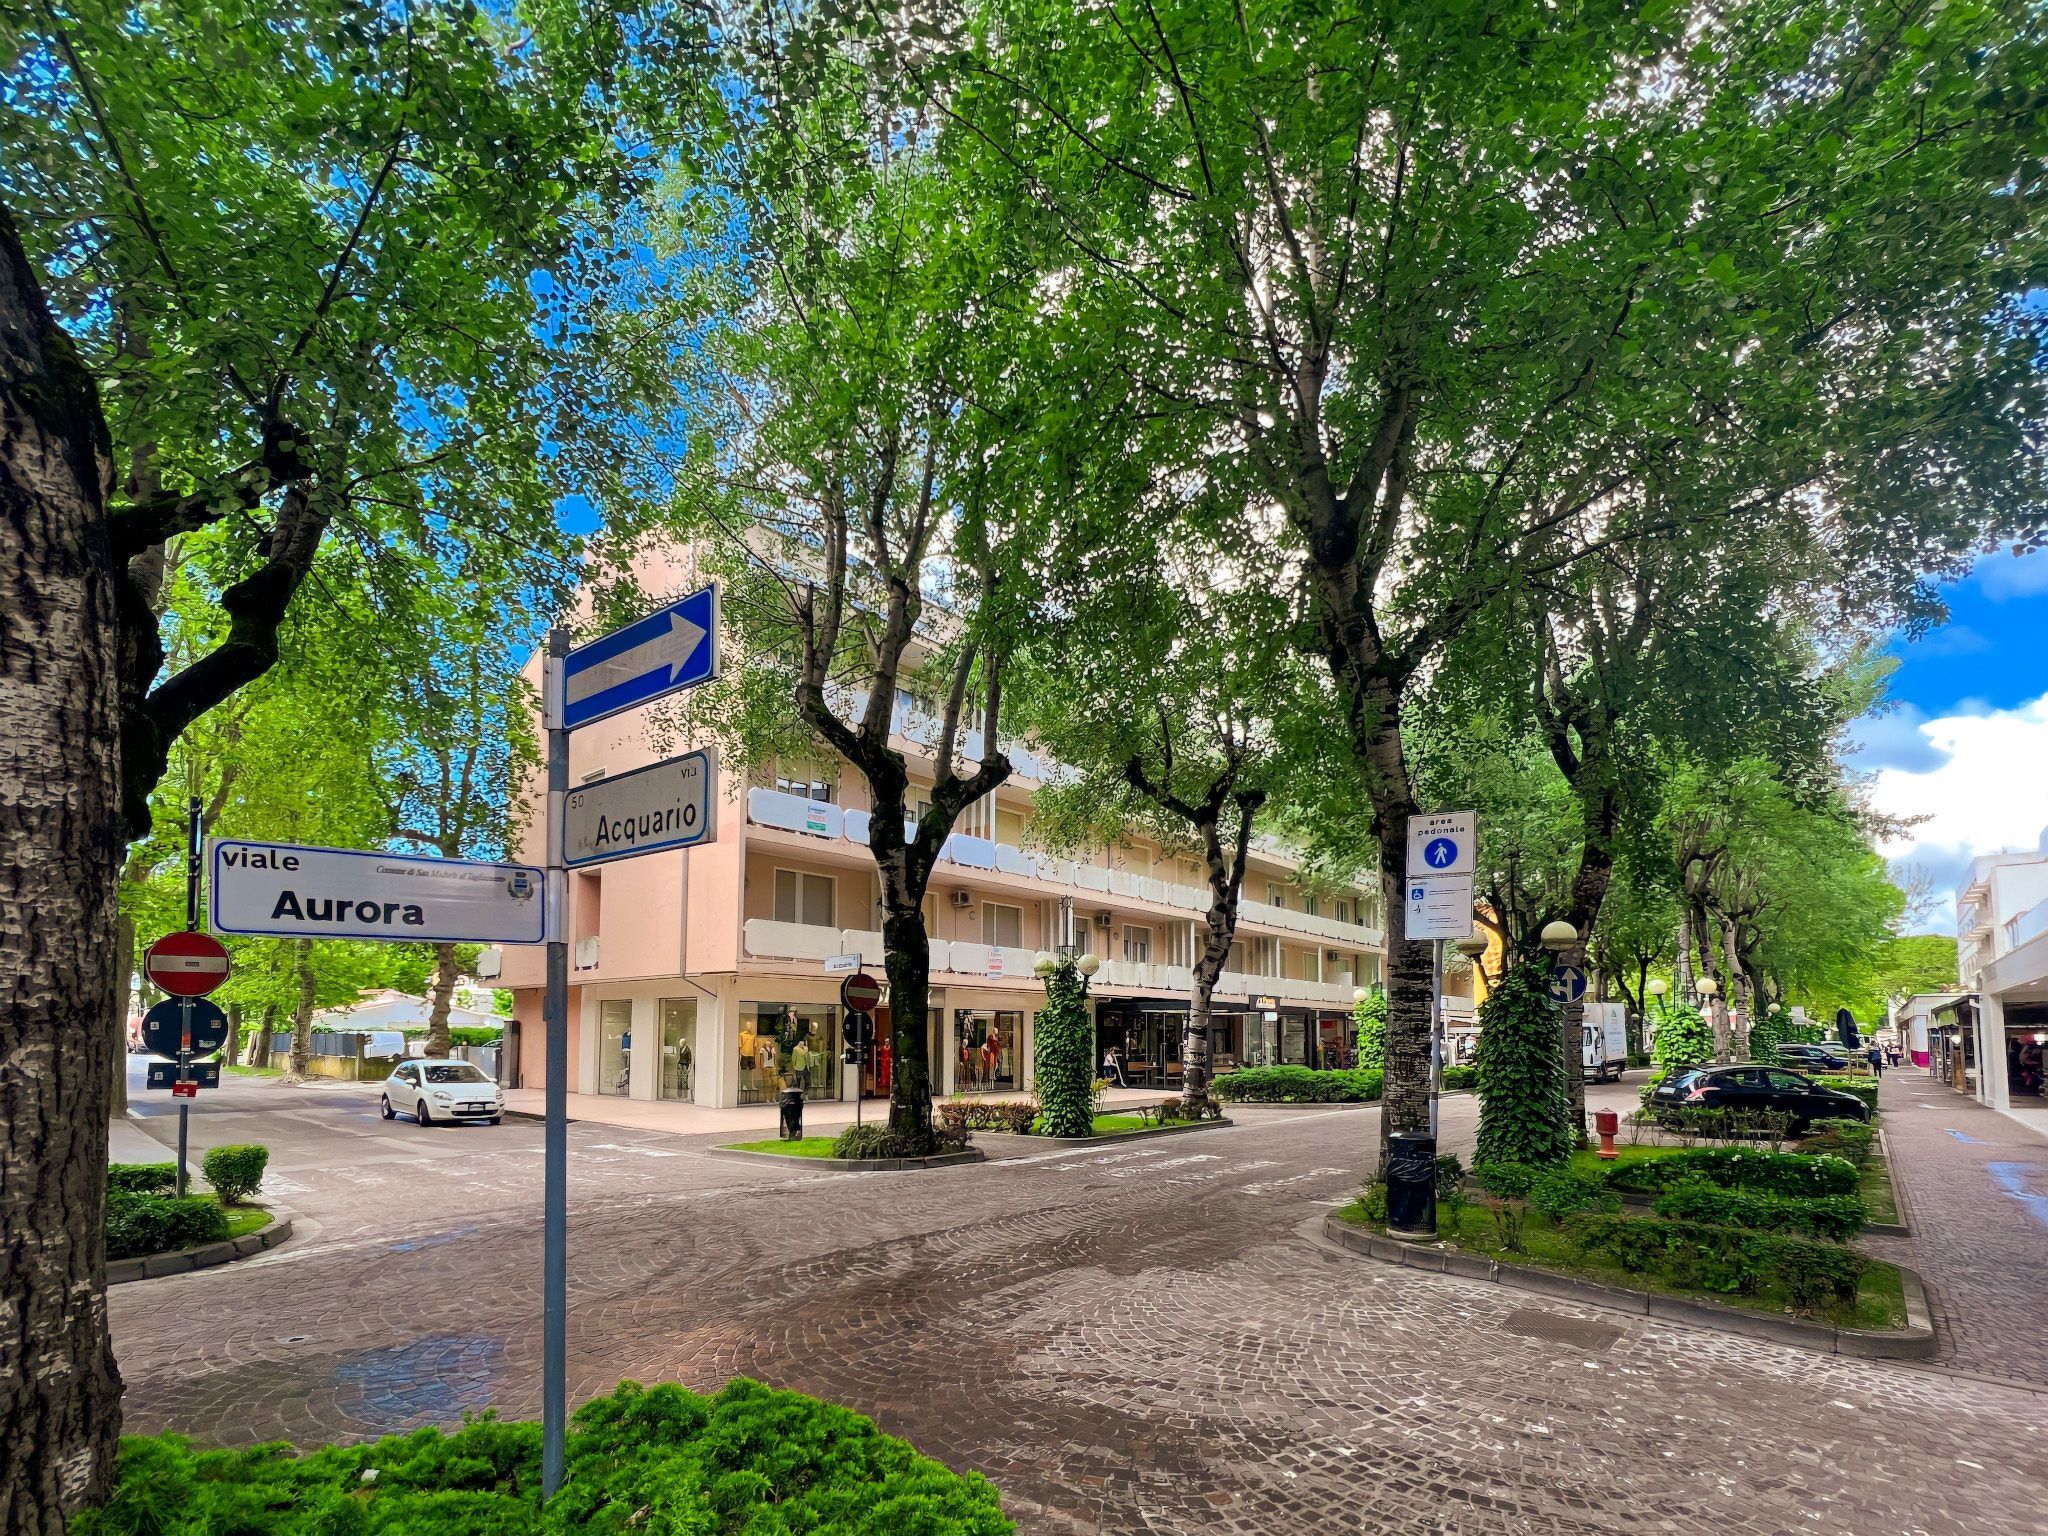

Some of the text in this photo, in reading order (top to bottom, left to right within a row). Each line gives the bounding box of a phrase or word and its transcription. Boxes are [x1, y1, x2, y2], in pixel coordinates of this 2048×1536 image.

[595, 797, 697, 847] Acquario
[1417, 826, 1465, 837] pedonale
[1429, 818, 1453, 826] area
[221, 847, 300, 872] viale
[270, 890, 425, 926] Aurora
